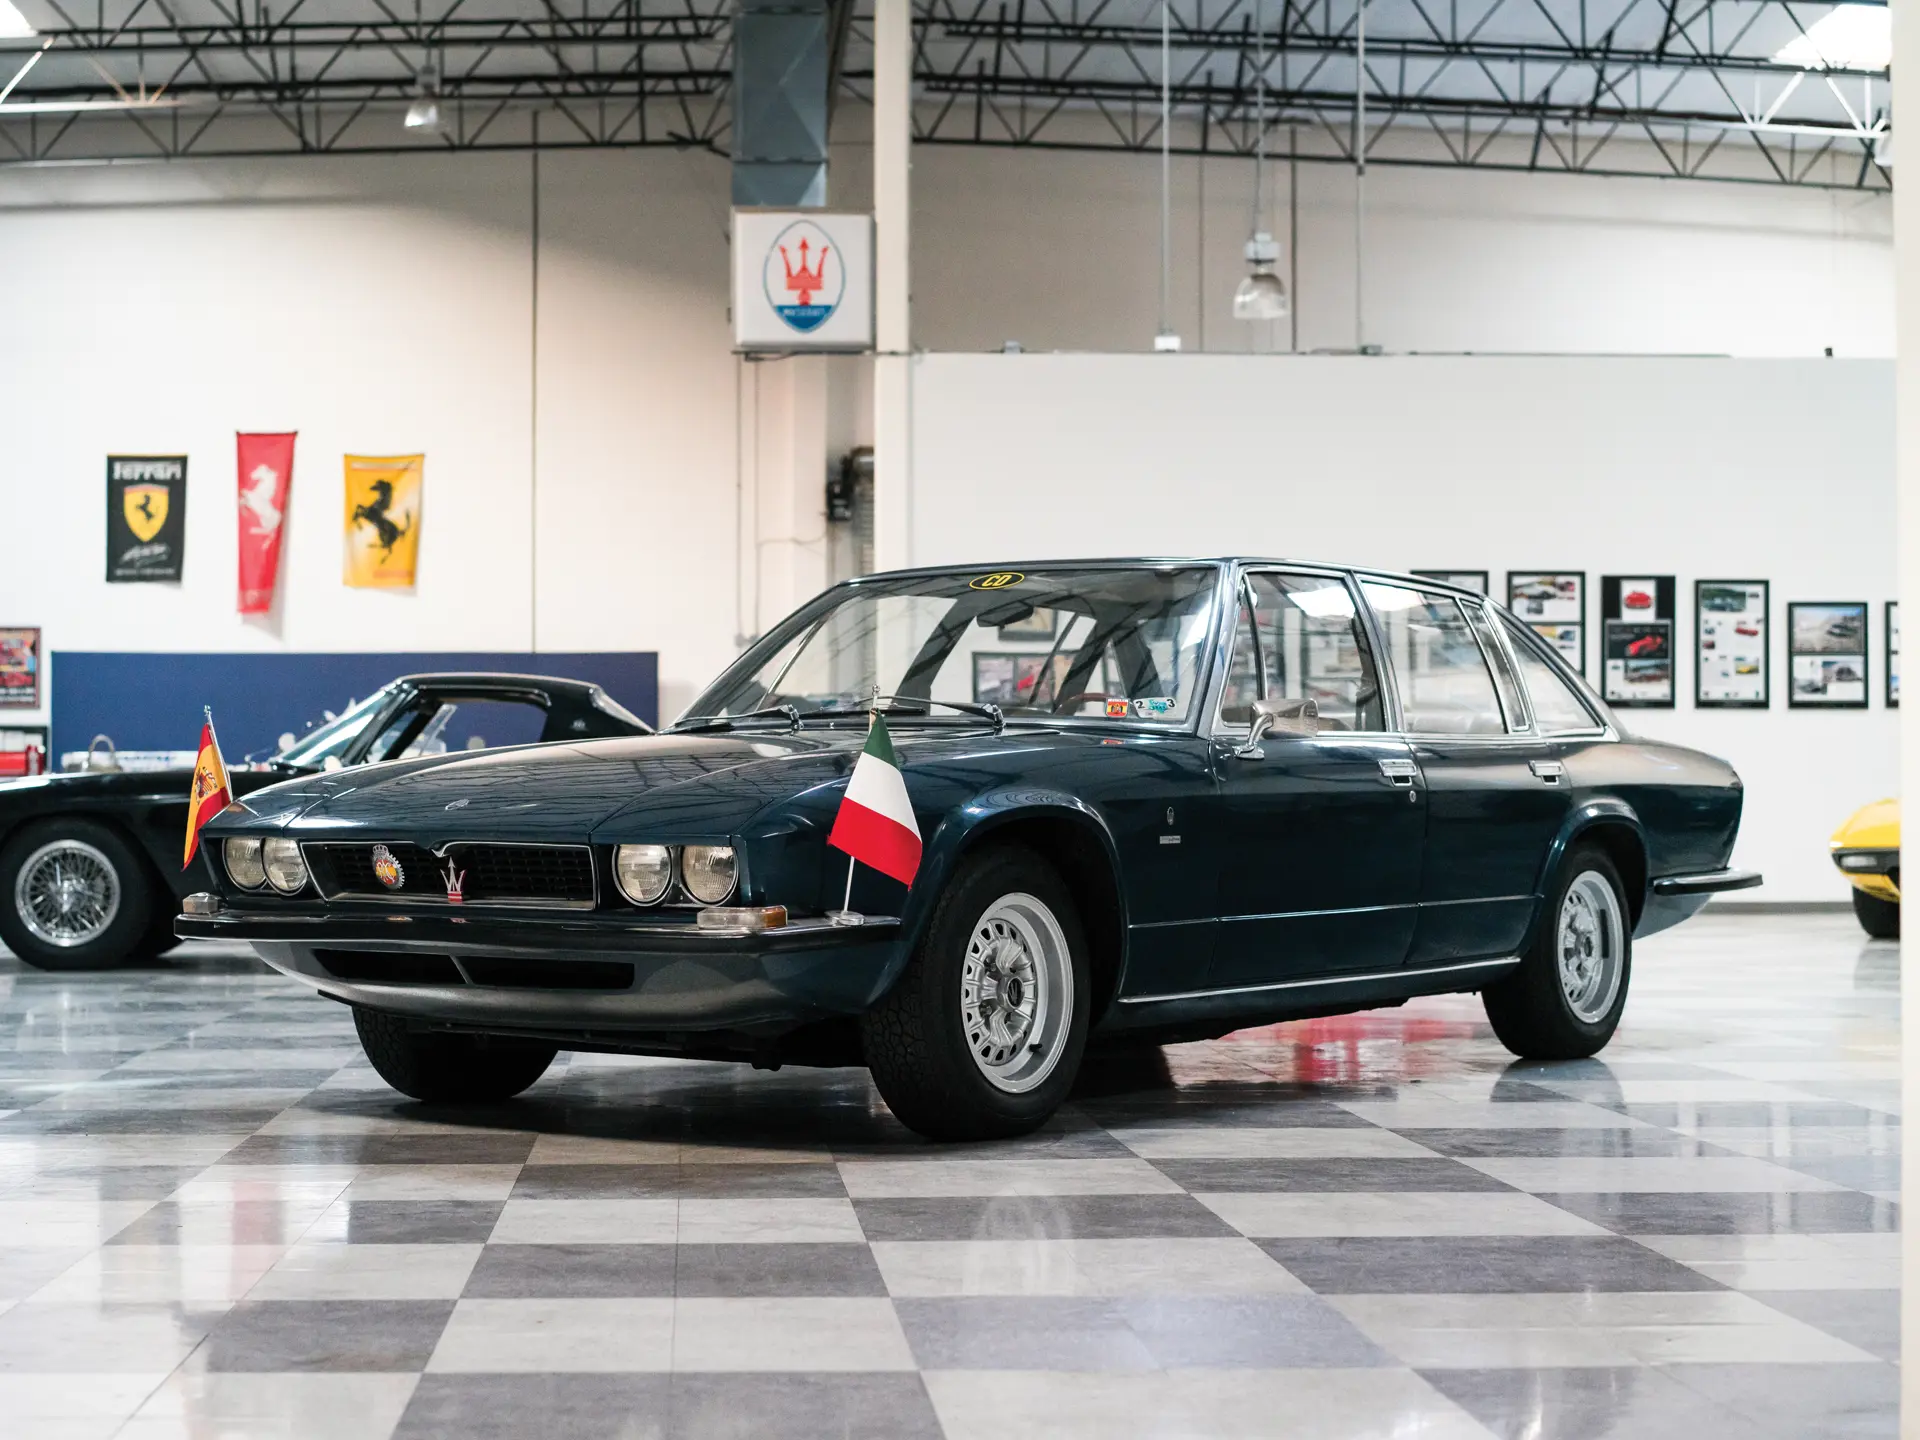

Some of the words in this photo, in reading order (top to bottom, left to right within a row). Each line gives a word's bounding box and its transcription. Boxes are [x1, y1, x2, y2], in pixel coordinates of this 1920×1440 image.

[982, 575, 1012, 586] CD
[1135, 700, 1145, 709] 2
[1166, 698, 1176, 708] 3
